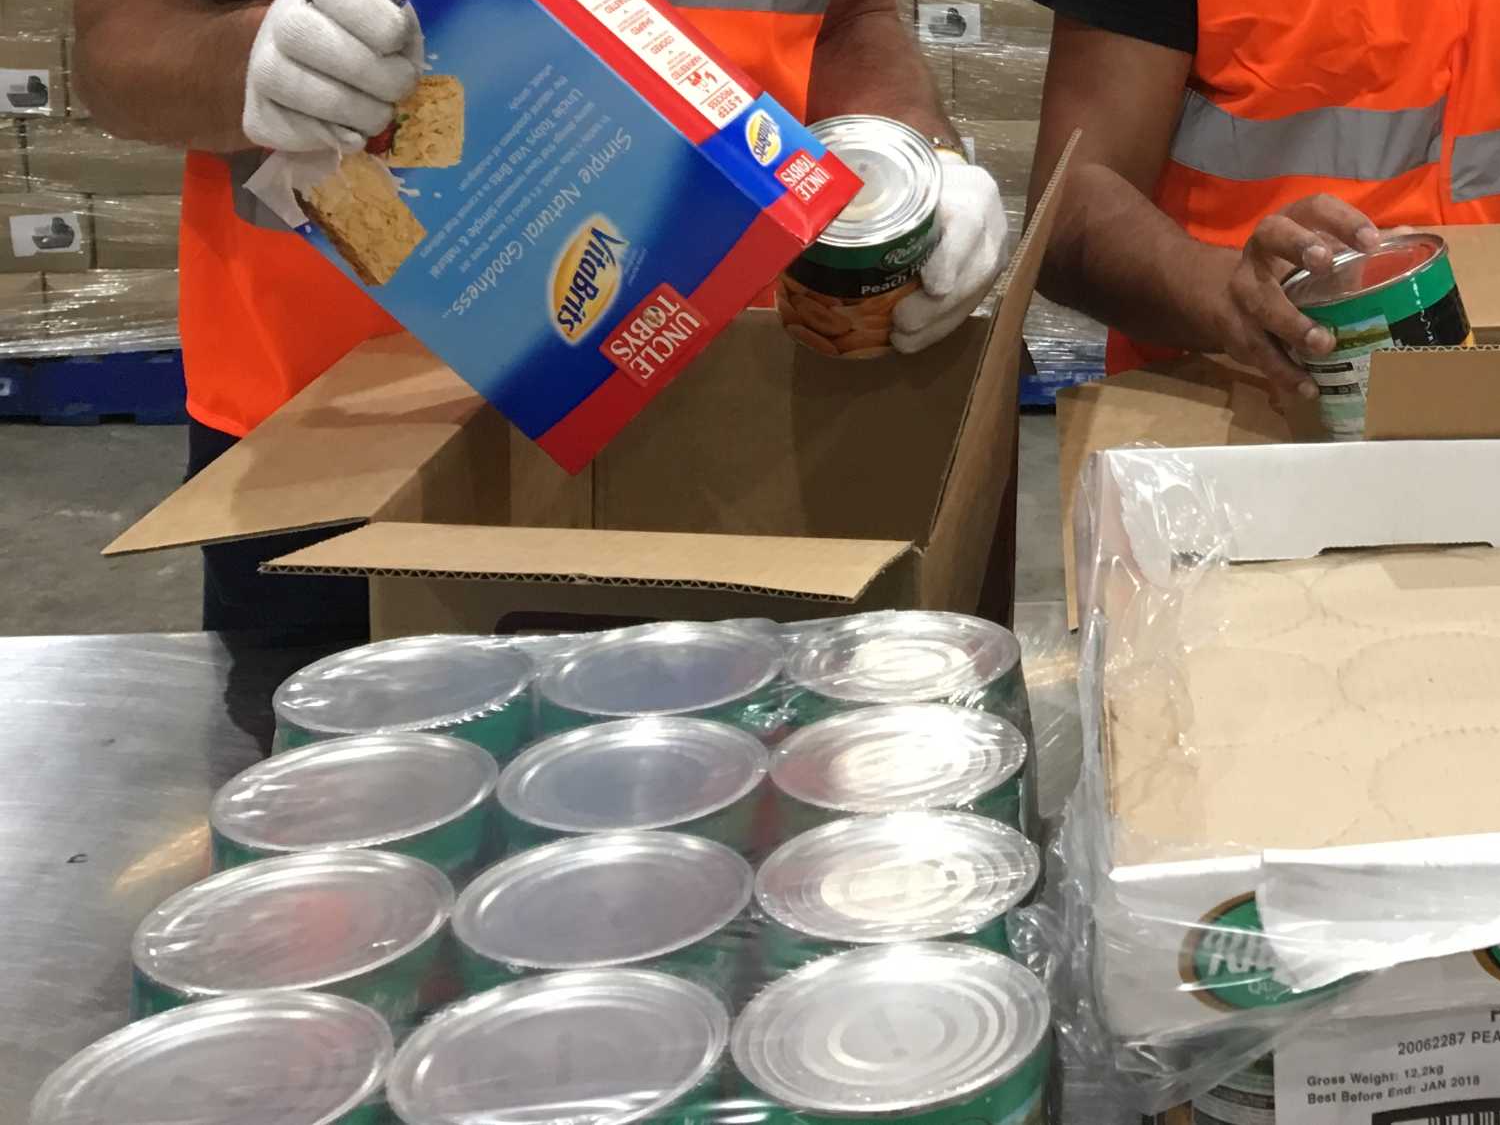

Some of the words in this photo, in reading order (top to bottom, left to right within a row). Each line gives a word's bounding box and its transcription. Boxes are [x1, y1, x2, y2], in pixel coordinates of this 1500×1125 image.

[574, 125, 632, 185] Simple
[752, 115, 778, 159] VitaBrits
[778, 154, 816, 188] TOBYS
[793, 167, 831, 201] UNCLE
[519, 178, 584, 244] Natural
[555, 227, 624, 333] VitaBrits
[861, 274, 907, 295] Peach
[607, 290, 681, 363] TOBYS
[627, 308, 701, 381] UNCLE
[1397, 1032, 1466, 1056] 20062287
[1306, 1074, 1346, 1087] Gross
[1350, 1072, 1399, 1087] Weight:
[1404, 1064, 1444, 1079] 12.2kg
[1307, 1092, 1337, 1105] Best
[1341, 1090, 1383, 1104] Before
[1387, 1086, 1416, 1098] End:
[1420, 1079, 1446, 1093] JAN
[1450, 1075, 1481, 1088] 2018
